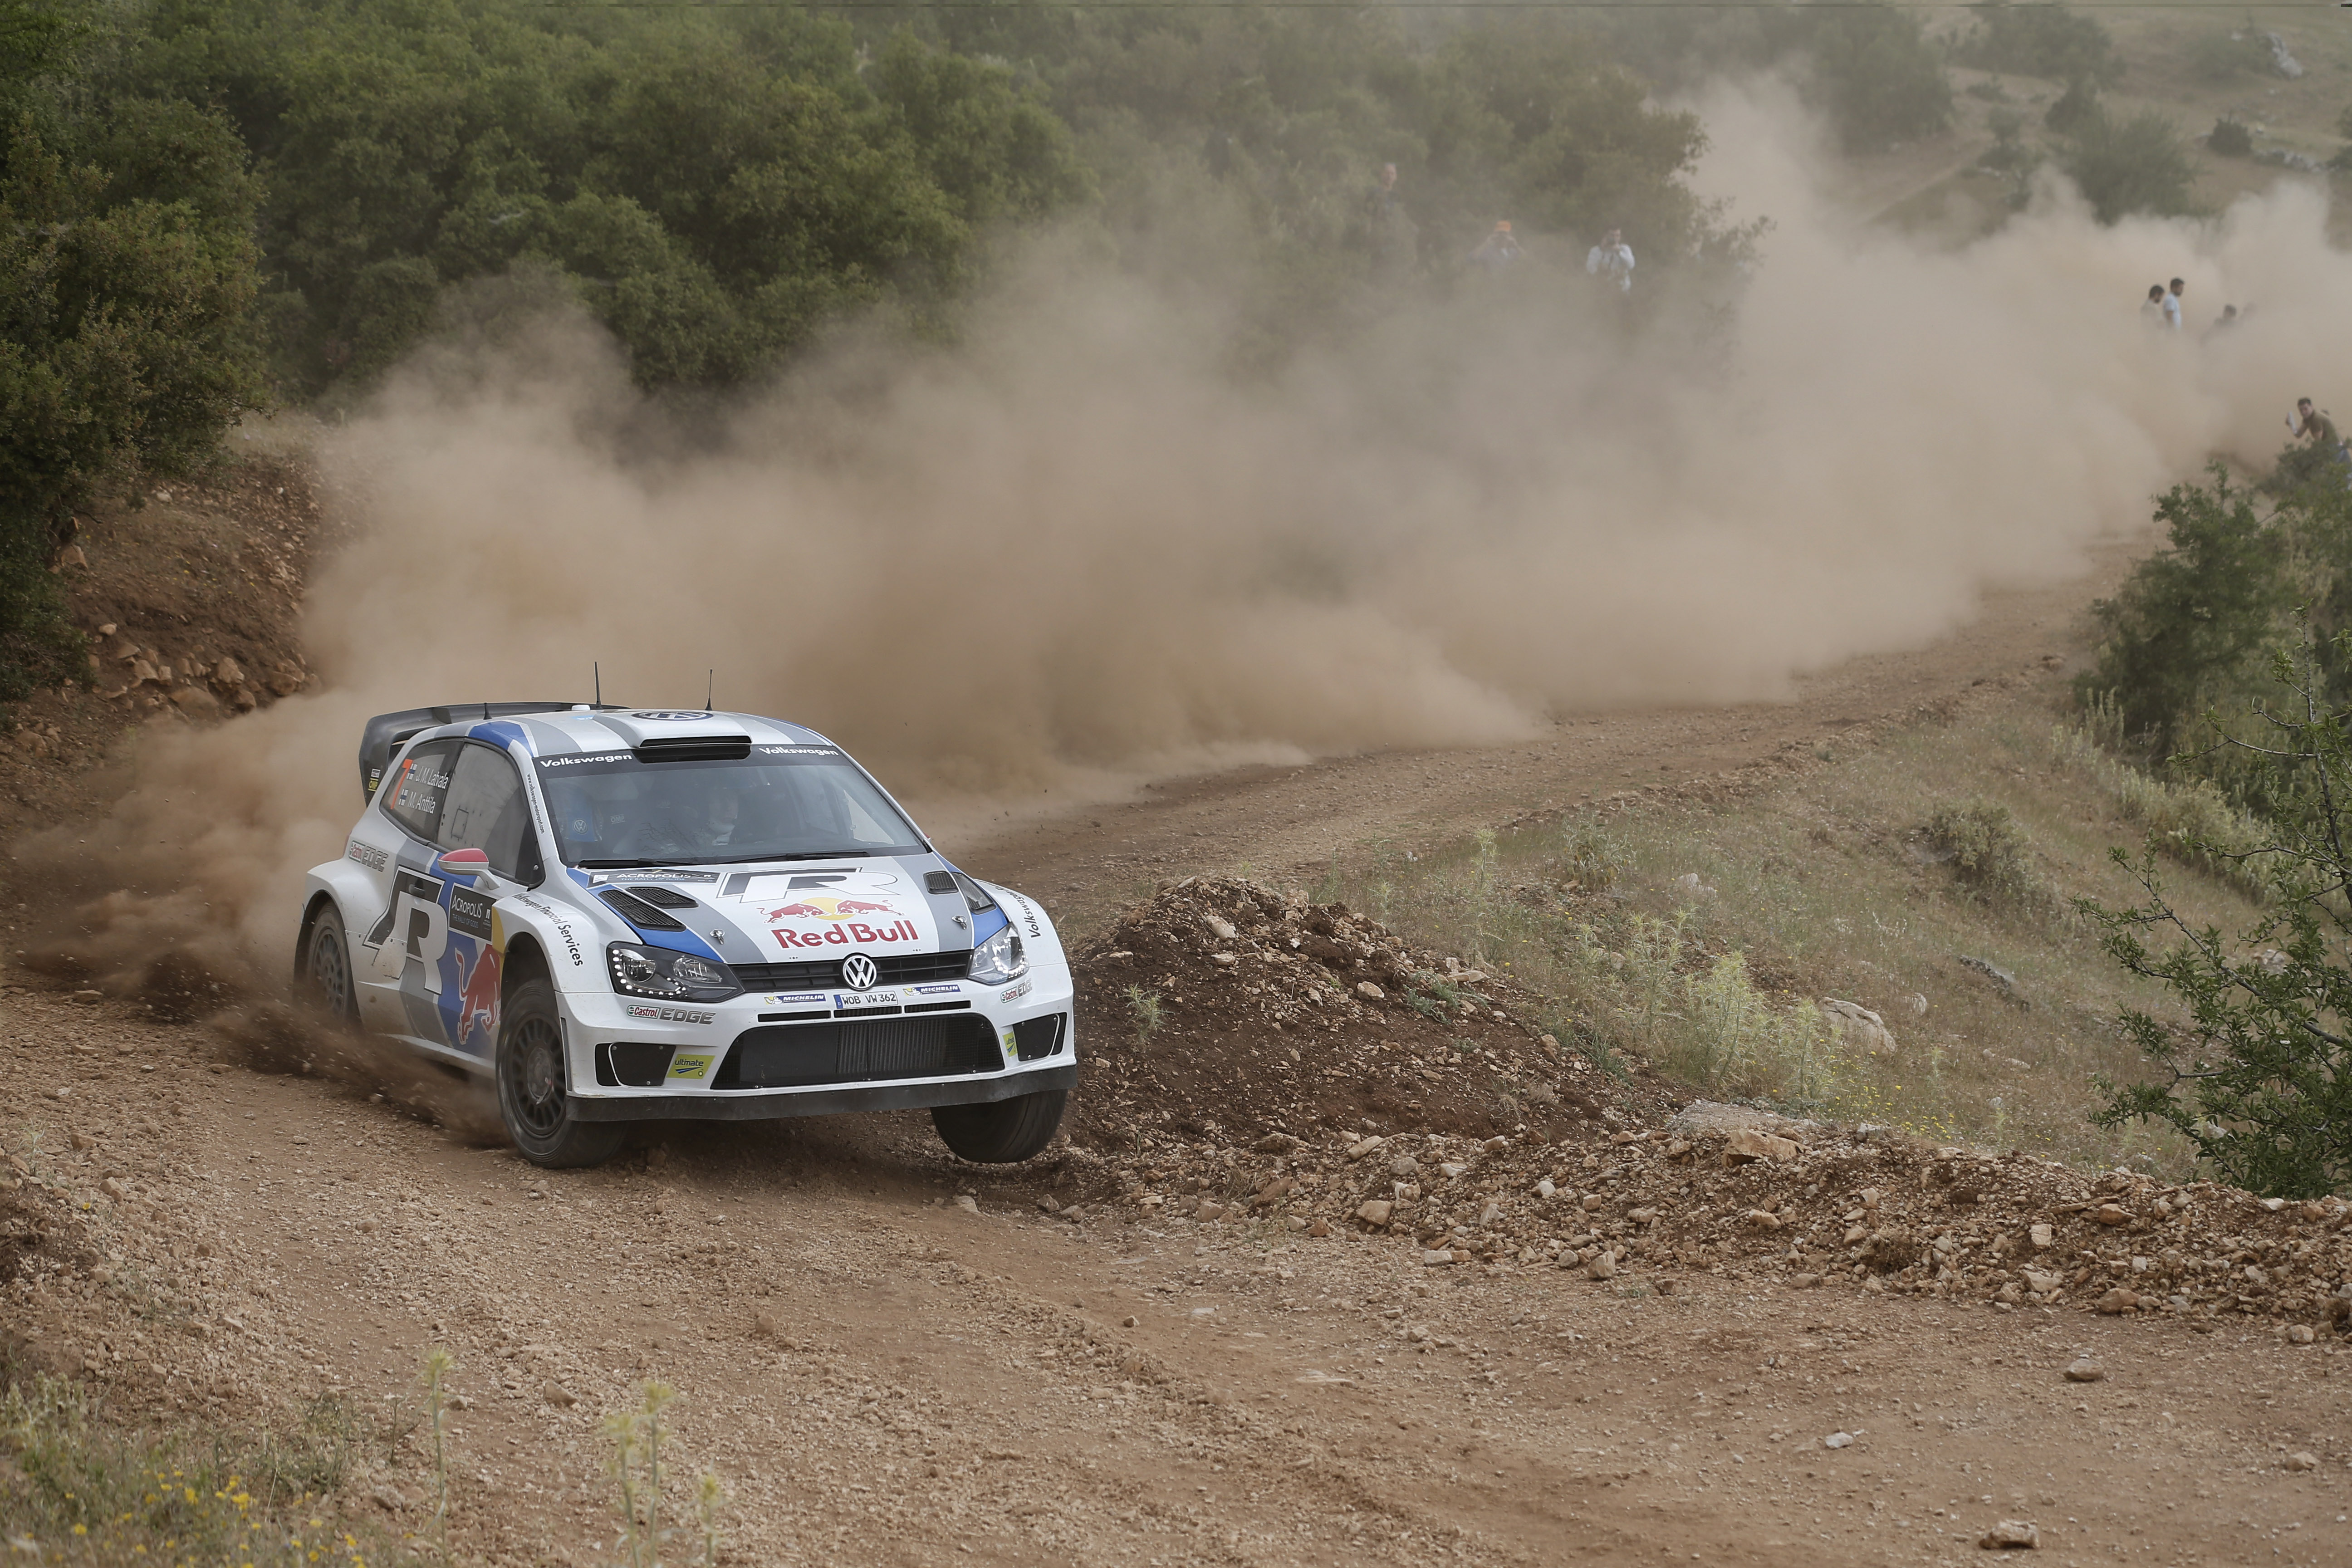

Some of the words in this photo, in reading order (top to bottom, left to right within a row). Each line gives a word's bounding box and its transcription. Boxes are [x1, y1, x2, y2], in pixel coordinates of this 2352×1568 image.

[540, 755, 632, 767] Volkswagen
[759, 747, 838, 756] Volkswagen
[391, 759, 413, 809] 7
[427, 769, 448, 789] Latvala
[451, 895, 483, 918] ACROPOLIS
[771, 924, 849, 949] Red
[848, 921, 918, 943] Bull
[558, 925, 583, 966] Services
[842, 996, 861, 1004] WOB
[865, 995, 877, 1003] VW
[879, 994, 896, 1002] 362
[634, 1007, 658, 1017] Castrol
[659, 1008, 716, 1025] EDGE
